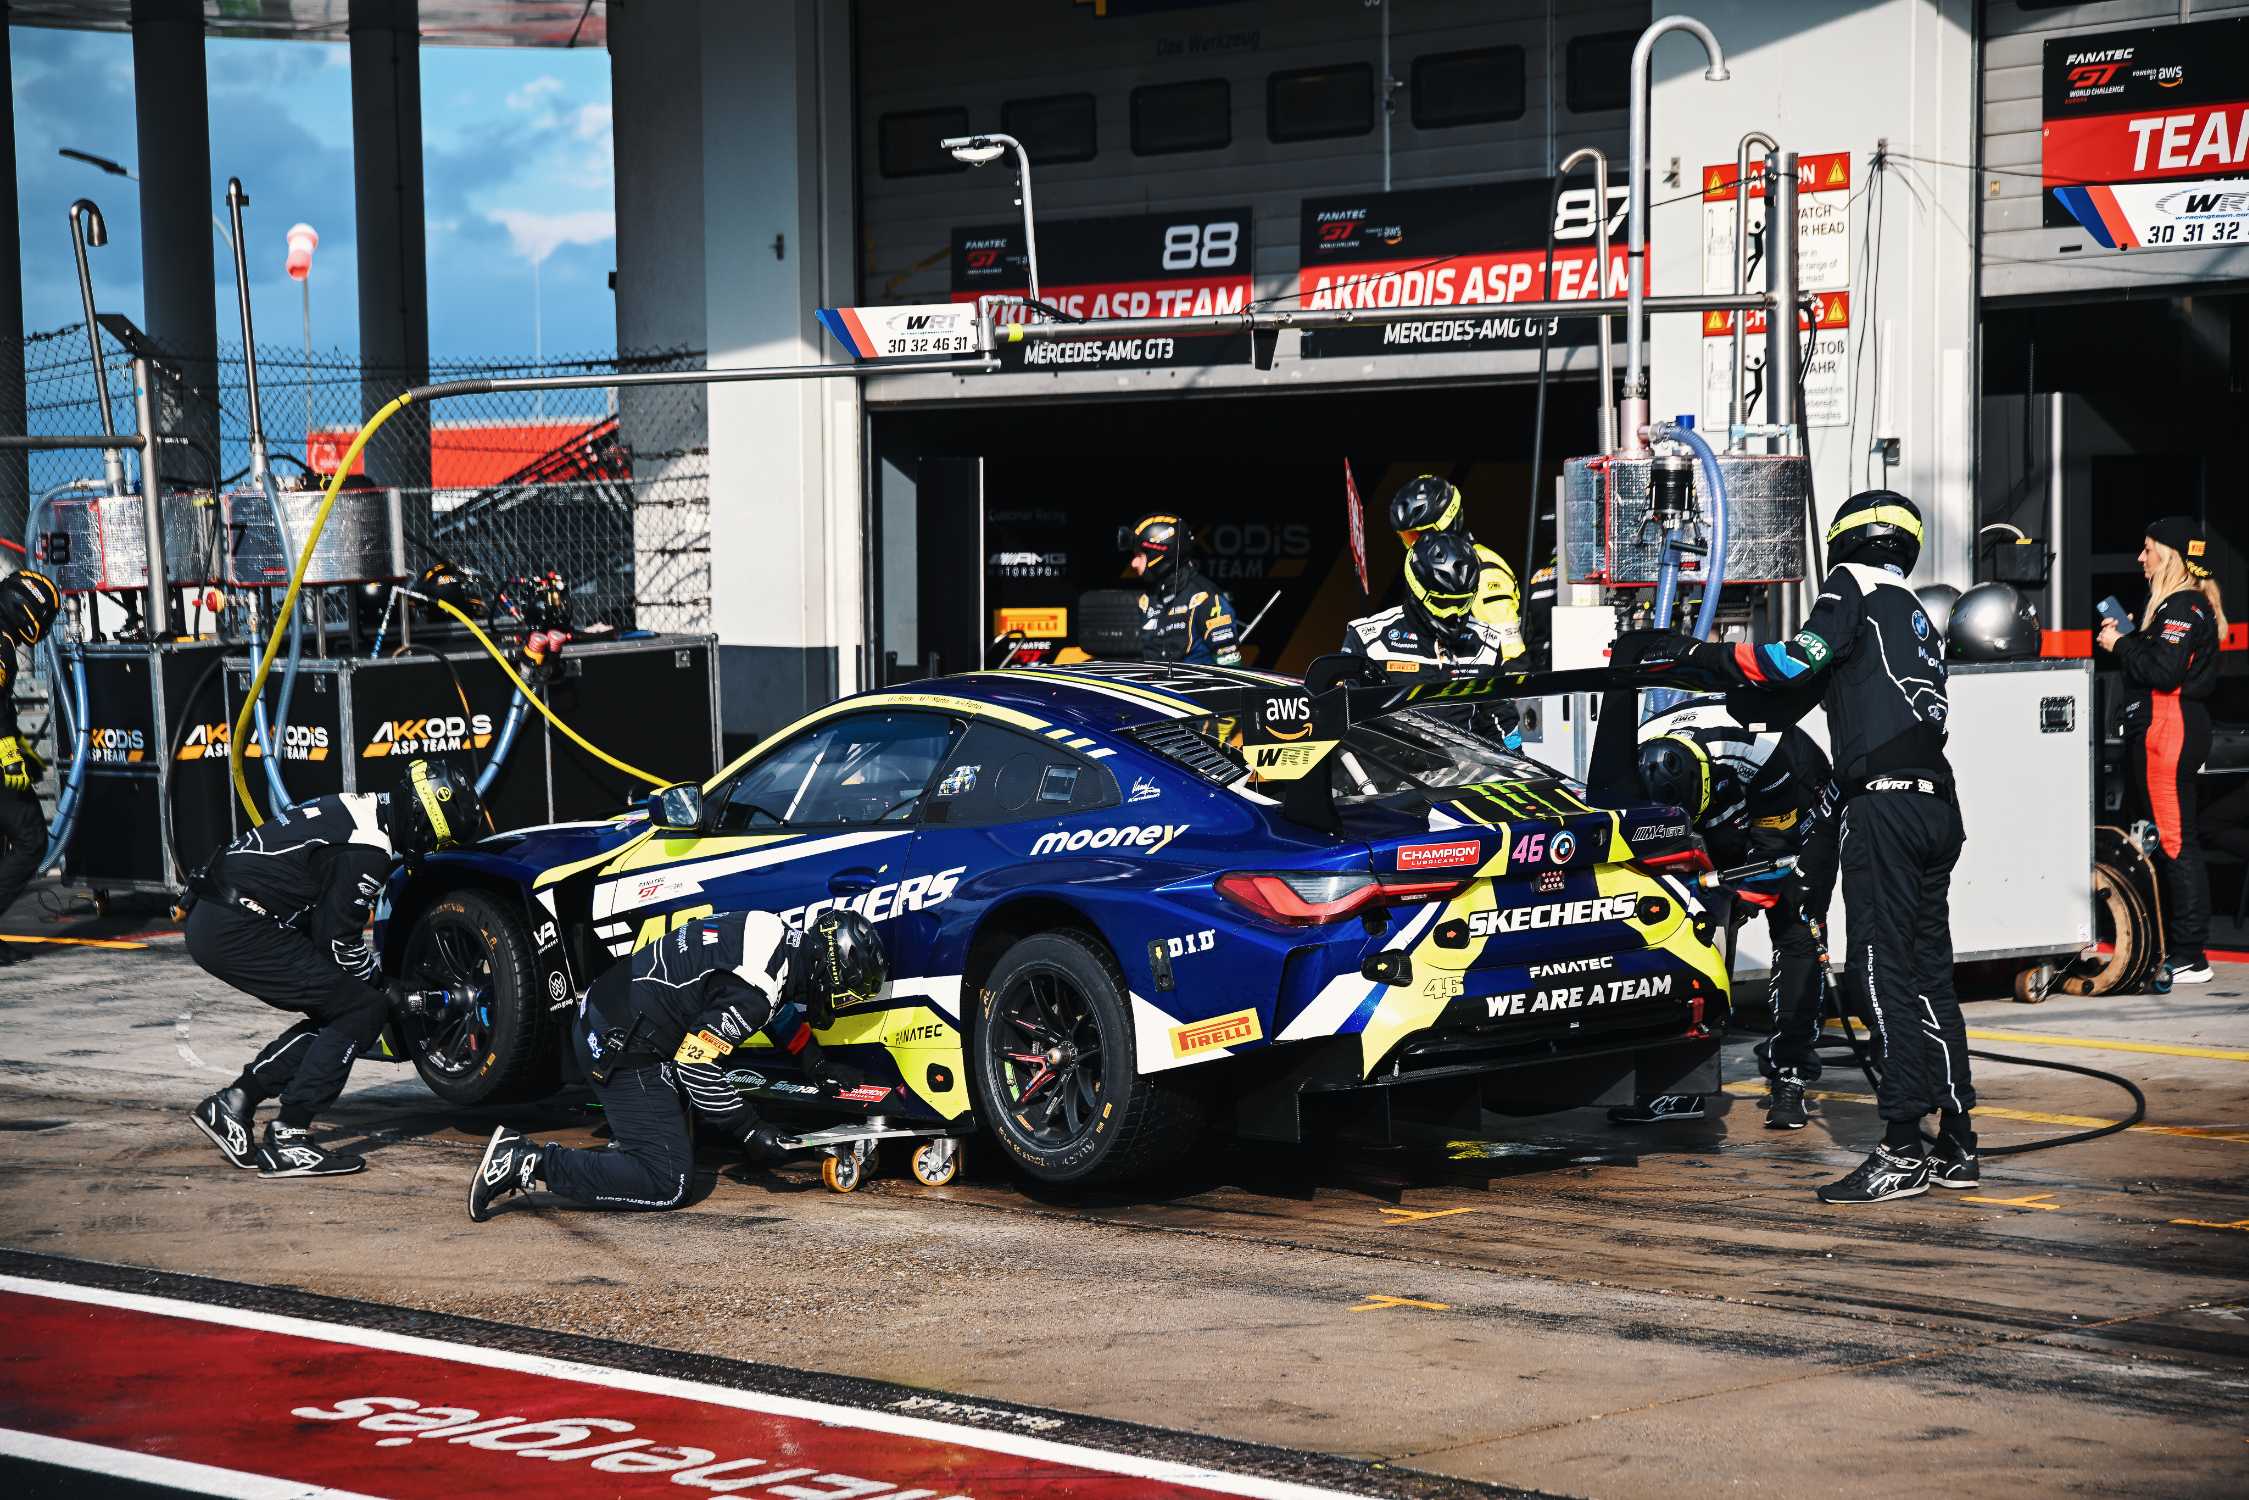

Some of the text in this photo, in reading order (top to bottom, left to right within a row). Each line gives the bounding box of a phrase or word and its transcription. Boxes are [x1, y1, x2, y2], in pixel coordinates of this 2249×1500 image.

[2066, 47, 2135, 66] FANATEC
[2158, 65, 2182, 80] aws
[2069, 85, 2125, 98] WORLD CHALLENGE
[1553, 185, 1630, 240] 87
[1798, 204, 1832, 219] ATCH
[2185, 190, 2249, 213] WR
[1317, 208, 1368, 222] FANATEC
[1812, 222, 1845, 237] HEAD
[2148, 225, 2175, 244] 30
[2183, 223, 2204, 243] 31
[2212, 221, 2240, 241] 32
[965, 239, 1008, 249] FANATEC
[1162, 221, 1240, 271] 88
[1309, 268, 1456, 311] AKKODIS
[1458, 262, 1533, 304] ASP
[1092, 288, 1151, 320] ASP
[1156, 285, 1243, 319] TEAM
[888, 336, 968, 354] 30 32 46 31
[1024, 338, 1175, 365] MERCEDES-AMG GT3
[1266, 696, 1310, 721] aws
[102, 748, 127, 762] TEAM
[390, 736, 461, 756] ASP TEAM
[1876, 779, 1914, 791] WRT
[1029, 824, 1191, 856] mooney
[1511, 833, 1546, 864] 46
[1401, 847, 1476, 861] CHAMPION
[1411, 856, 1465, 866] LUBRICANTS
[1469, 893, 1637, 938] SKECHERS
[533, 920, 558, 946] VR
[1167, 929, 1215, 958] D.I.D
[1529, 956, 1613, 979] FANATEC
[1423, 975, 1465, 1000] 46
[1485, 974, 1672, 1018] WE ARE A TEAM
[895, 1023, 944, 1045] FANATEC
[1178, 1016, 1252, 1051] PIRELLI
